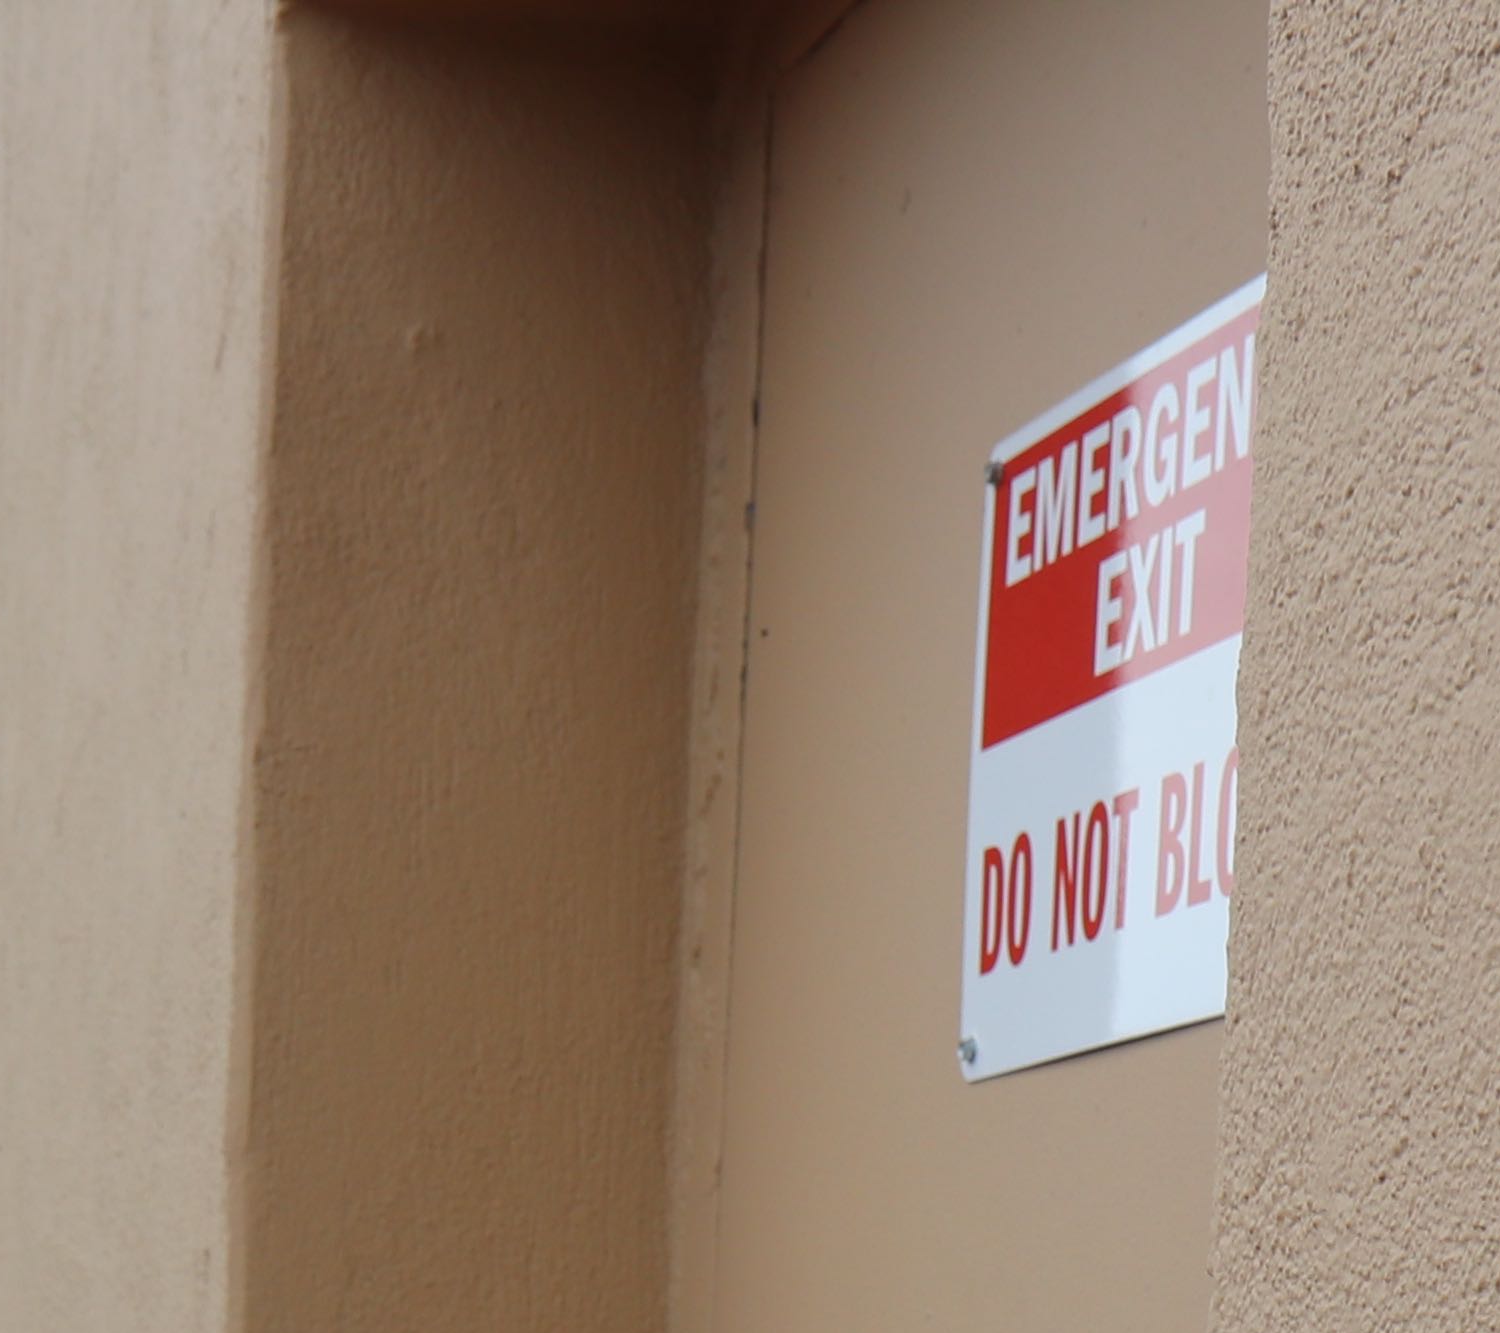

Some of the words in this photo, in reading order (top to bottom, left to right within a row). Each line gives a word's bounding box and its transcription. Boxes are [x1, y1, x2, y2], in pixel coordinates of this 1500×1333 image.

[1005, 333, 1255, 587] EMERGEN
[1094, 508, 1206, 677] EXIT
[980, 831, 1032, 976] DO
[1051, 787, 1139, 953] NOT
